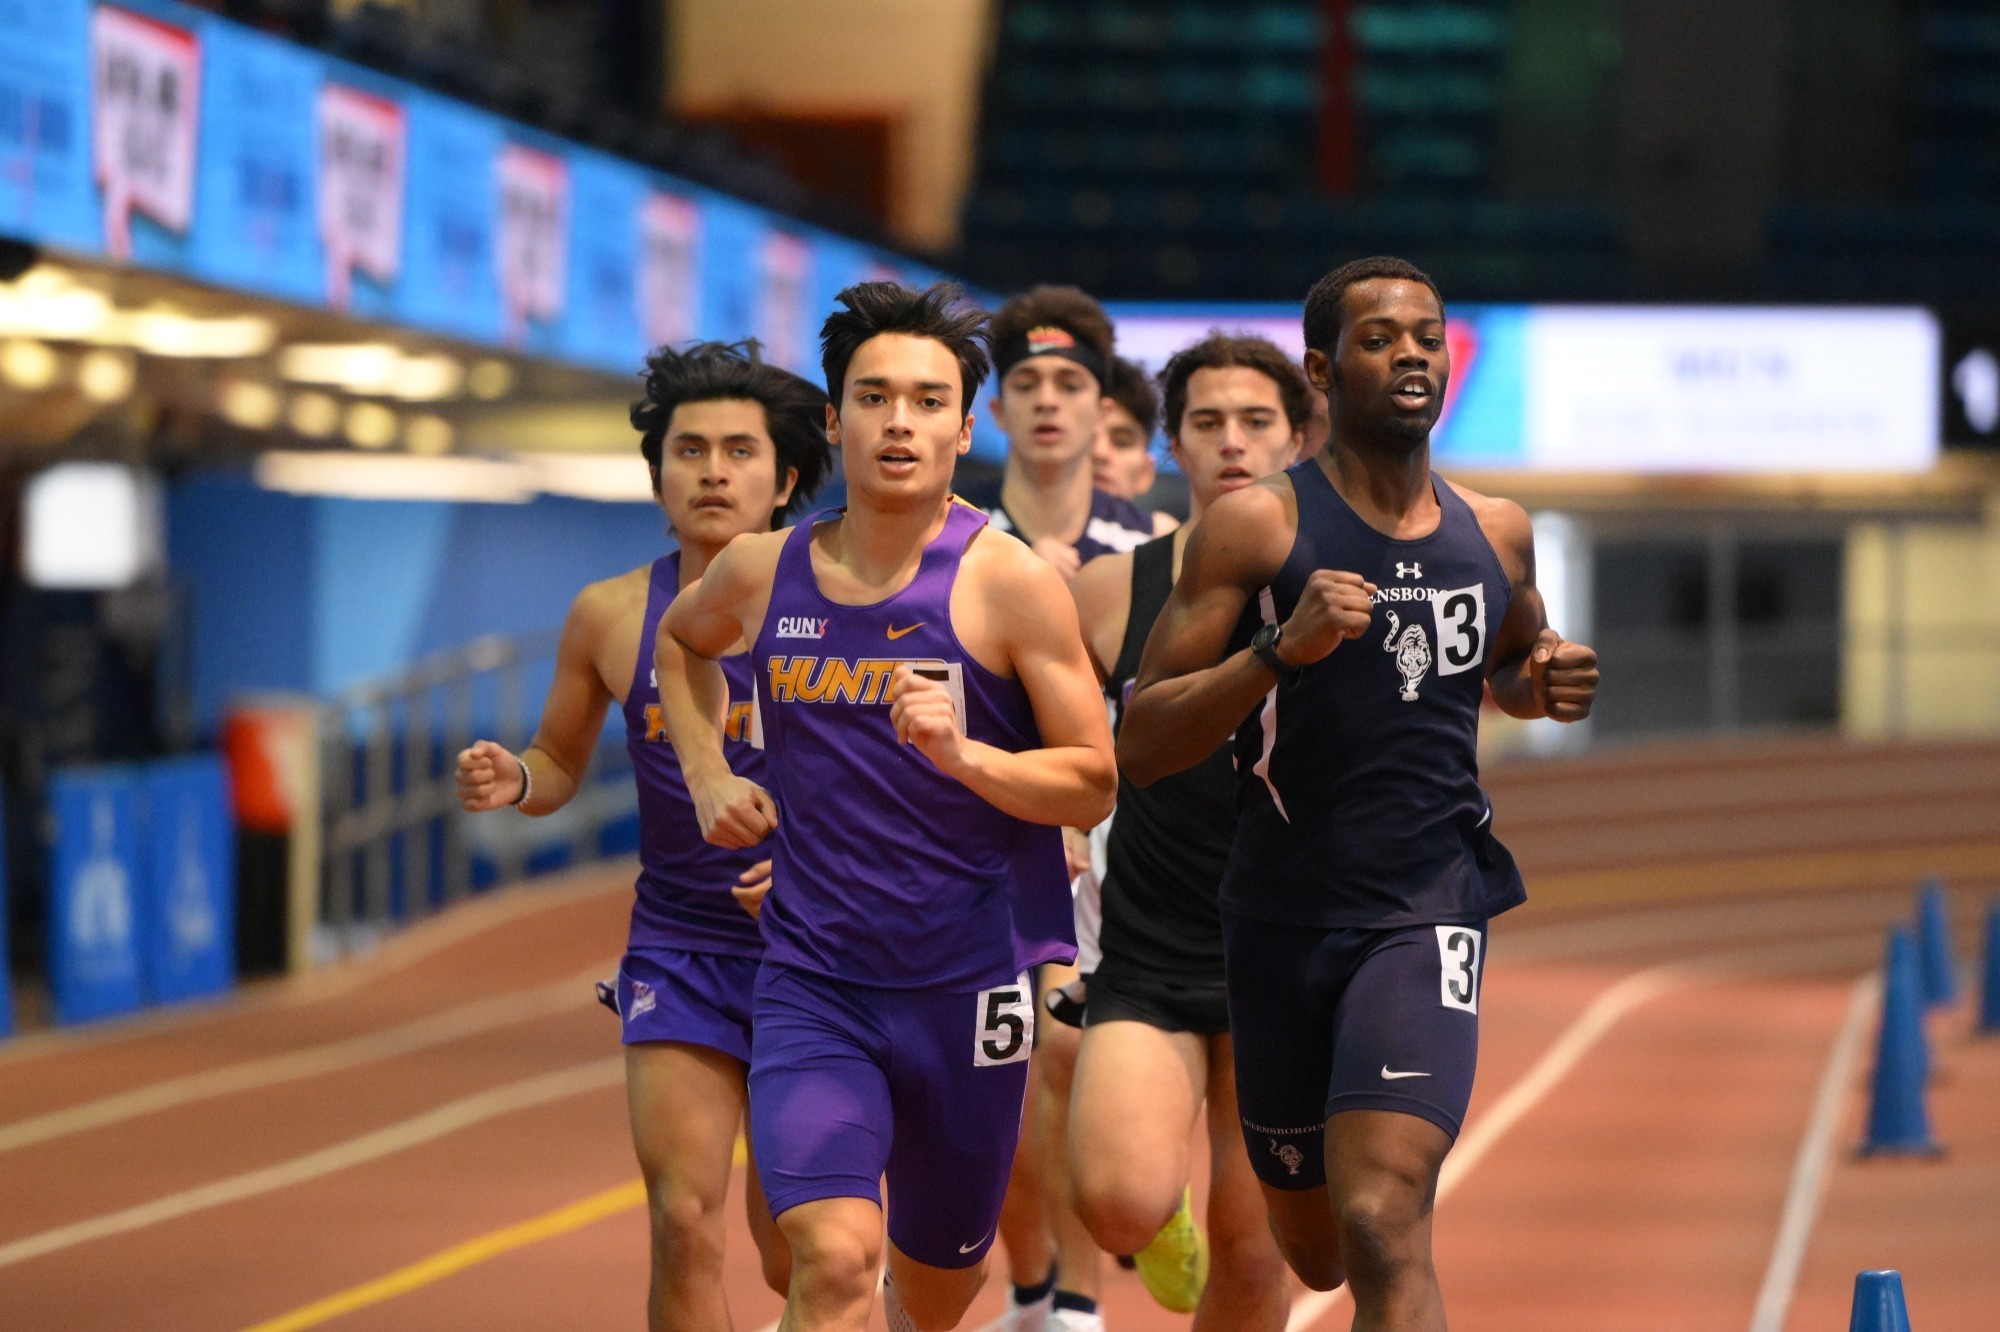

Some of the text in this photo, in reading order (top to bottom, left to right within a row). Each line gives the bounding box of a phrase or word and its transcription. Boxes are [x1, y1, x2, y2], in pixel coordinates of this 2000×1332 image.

[777, 616, 829, 636] CUNY
[1443, 593, 1480, 667] 3
[767, 656, 930, 704] HUNT
[1447, 931, 1475, 1004] 3
[982, 990, 1025, 1060] 5
